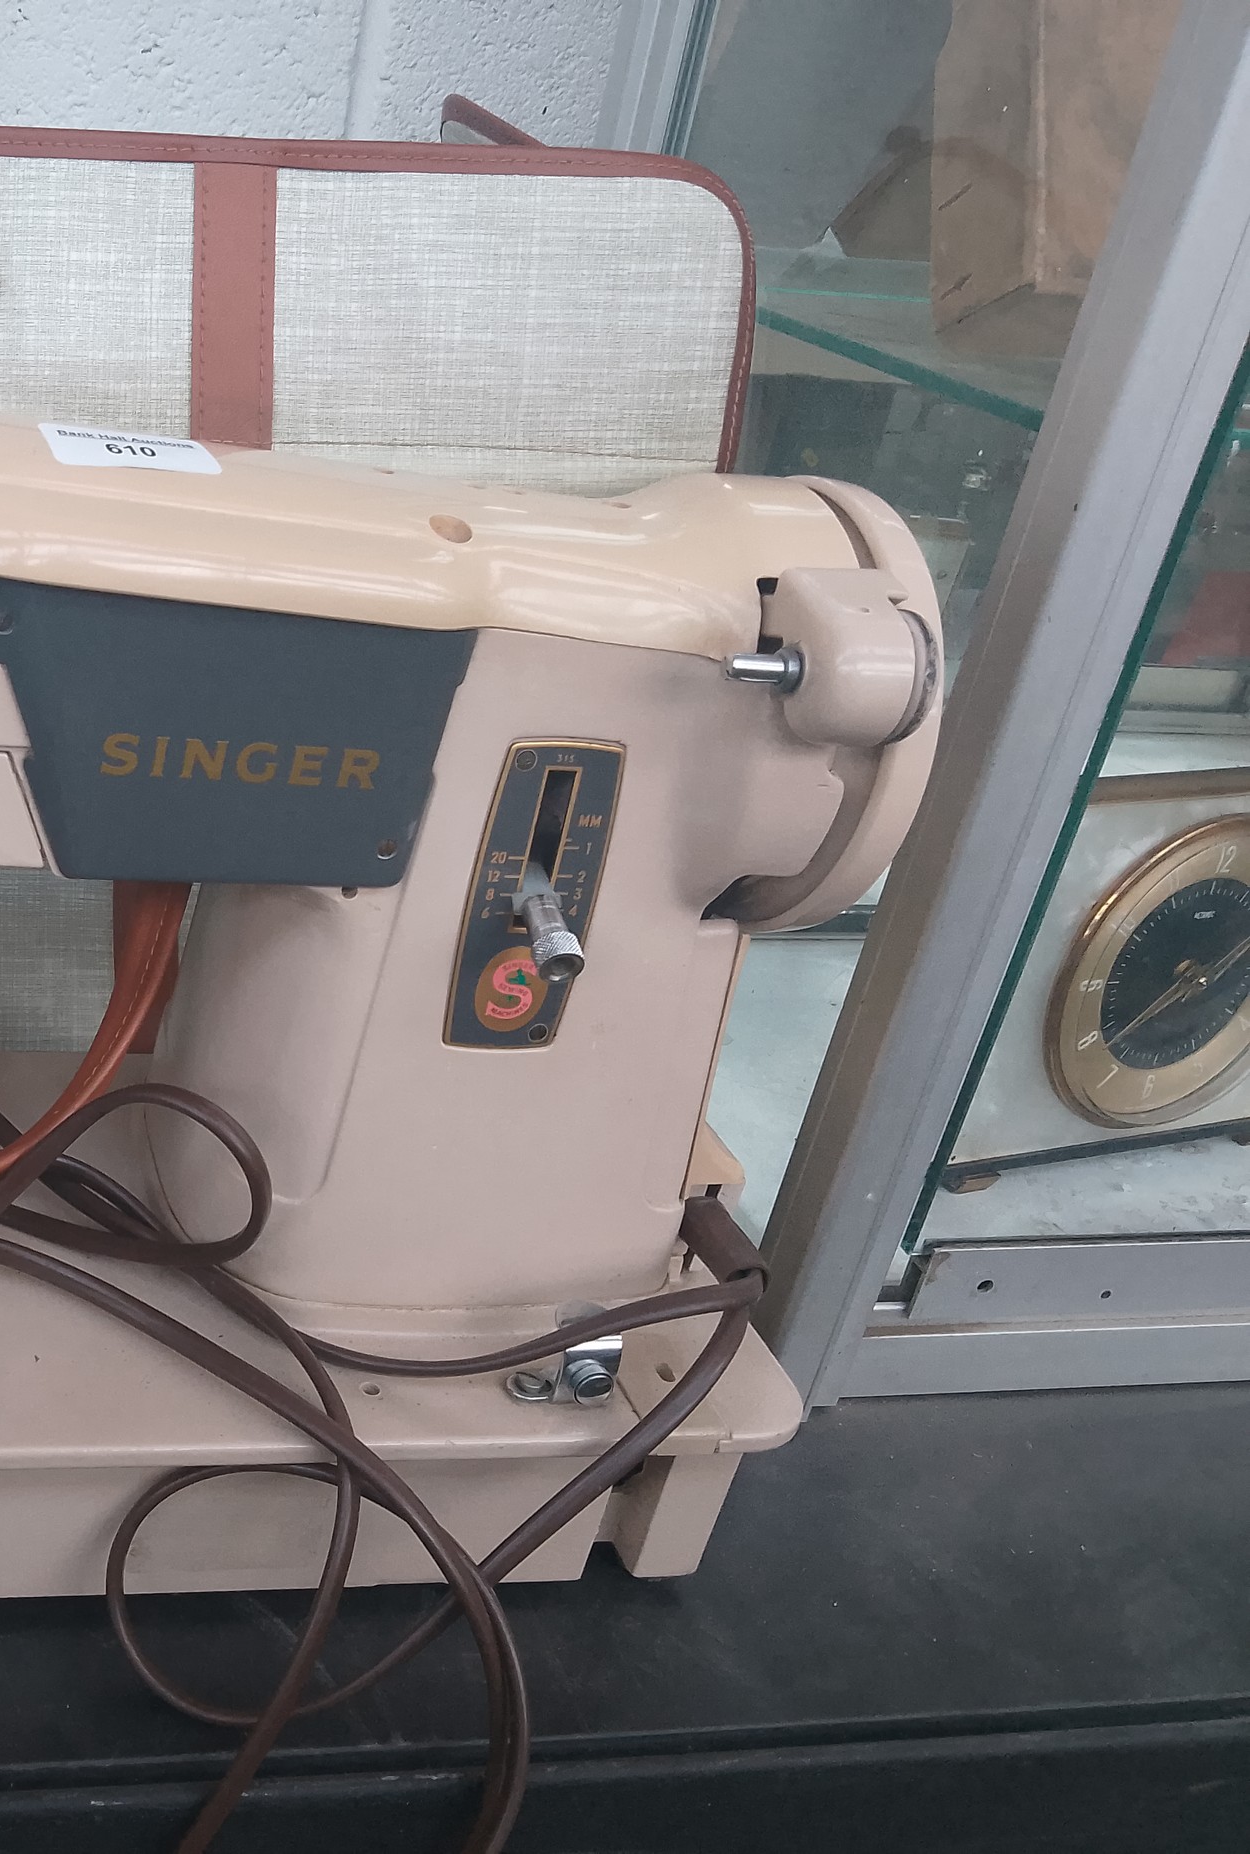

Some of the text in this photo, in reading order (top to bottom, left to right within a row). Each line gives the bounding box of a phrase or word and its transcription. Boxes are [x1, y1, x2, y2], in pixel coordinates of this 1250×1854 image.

[56, 429, 195, 449] Bank Hall Auctions
[105, 443, 157, 457] 610
[101, 732, 381, 790] SINGER
[578, 814, 603, 828] MM
[585, 842, 593, 855] 1
[491, 851, 507, 864] 20
[1214, 845, 1237, 873] 12
[487, 870, 501, 883] 12
[577, 870, 587, 883] 2
[485, 888, 495, 901] 8
[573, 887, 583, 900] 3
[480, 907, 490, 919] 6
[568, 904, 578, 917] 4
[1077, 1030, 1099, 1051] 8
[1096, 1064, 1119, 1088] 7
[1142, 1075, 1155, 1098] 6
